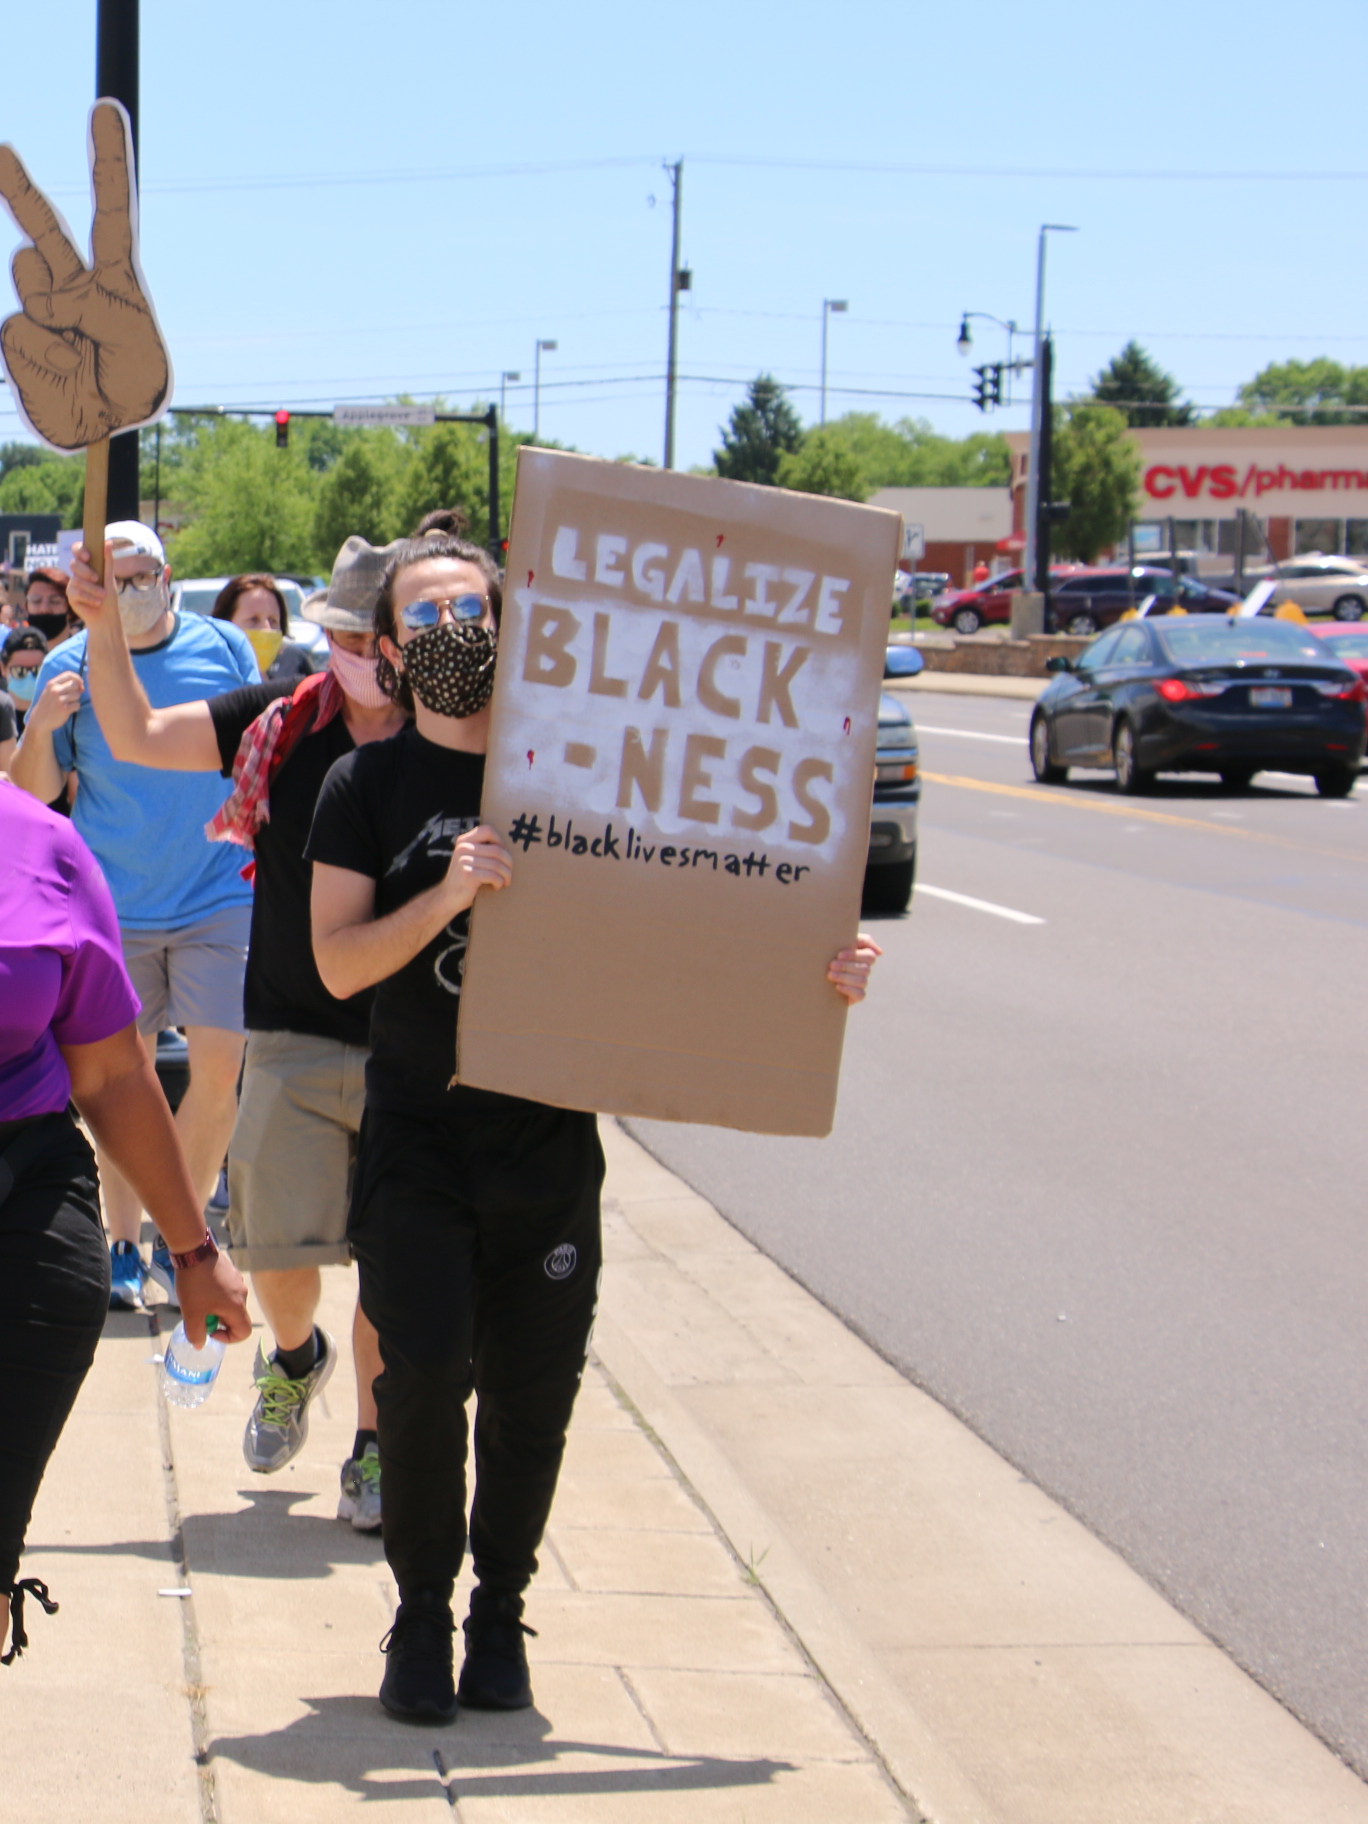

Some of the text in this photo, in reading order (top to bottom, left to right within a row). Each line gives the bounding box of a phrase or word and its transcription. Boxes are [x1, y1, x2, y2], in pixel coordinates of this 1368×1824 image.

[1144, 464, 1368, 498] CVS/pharm
[552, 526, 850, 635] LEGALIZE
[522, 603, 812, 729] BLACK
[508, 813, 811, 884] #blacklivesmatter
